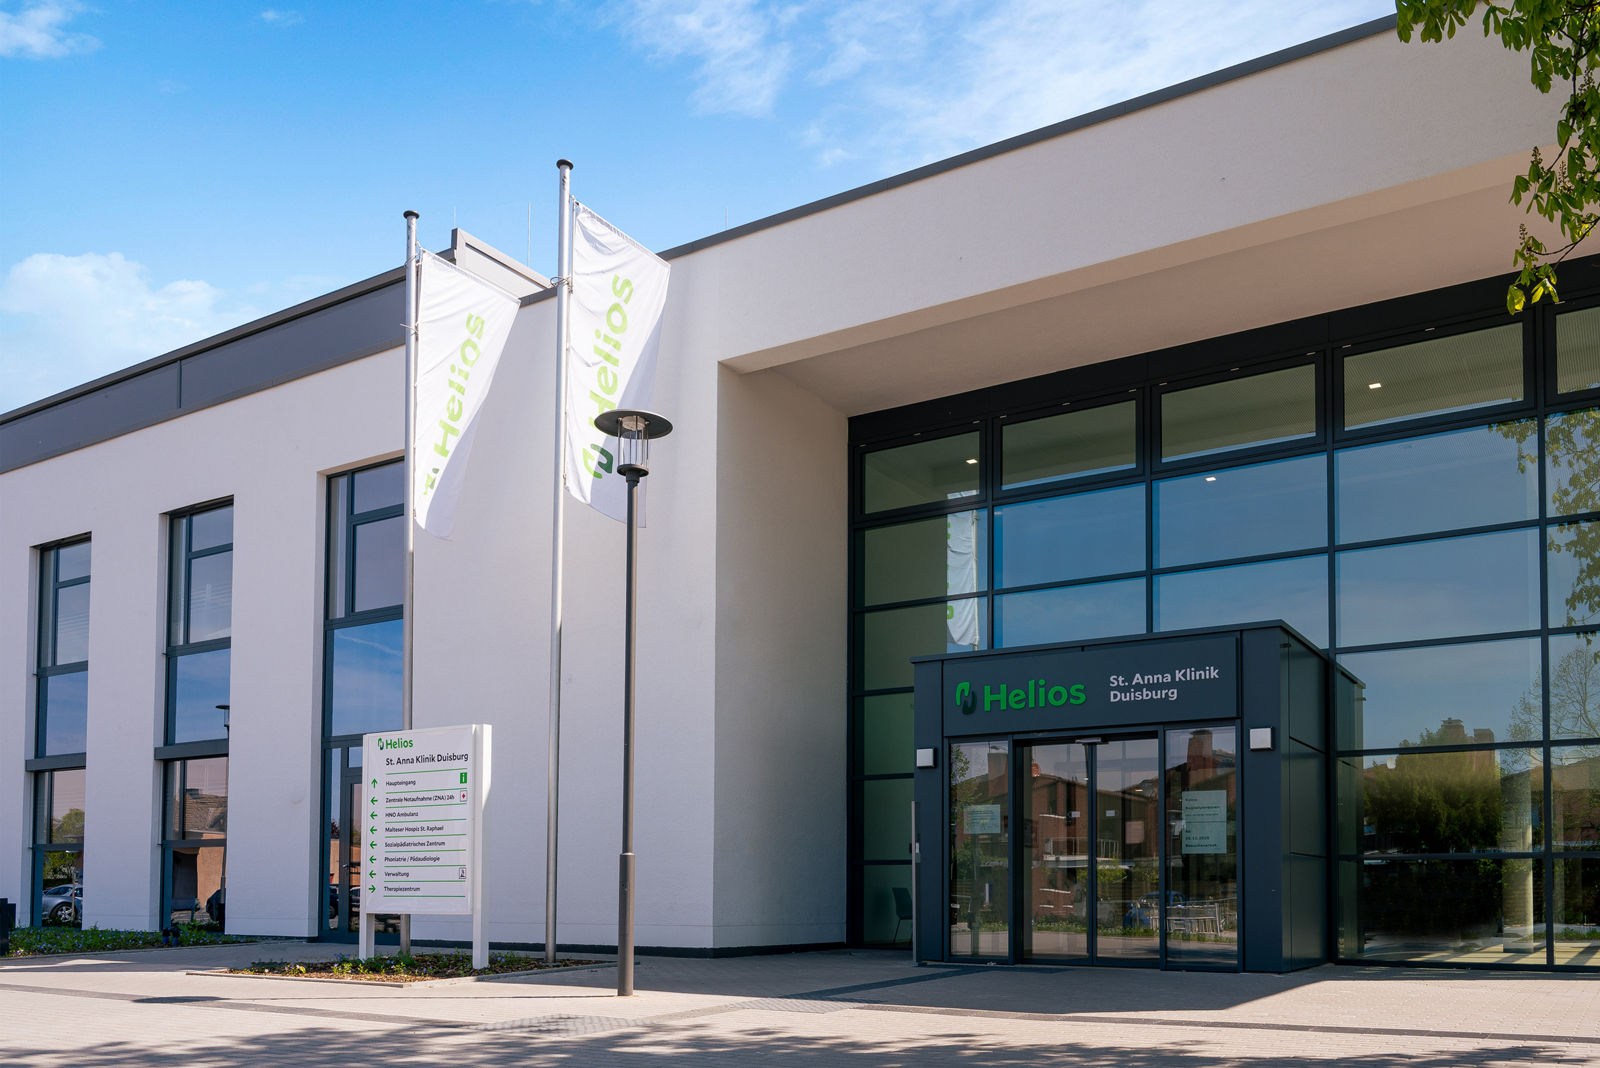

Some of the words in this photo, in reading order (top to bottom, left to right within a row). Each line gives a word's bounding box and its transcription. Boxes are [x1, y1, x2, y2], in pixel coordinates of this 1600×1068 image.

[434, 312, 485, 457] Helios
[1110, 675, 1128, 687] St.
[1132, 673, 1171, 686] Anna
[1175, 667, 1219, 682] Klinik
[984, 679, 1086, 711] Helios
[1110, 687, 1178, 702] Duisburg
[386, 738, 413, 750] Helios
[386, 757, 394, 766] St.
[396, 756, 414, 765] Anna
[415, 754, 436, 763] Klinik
[437, 753, 468, 762] Duisburg
